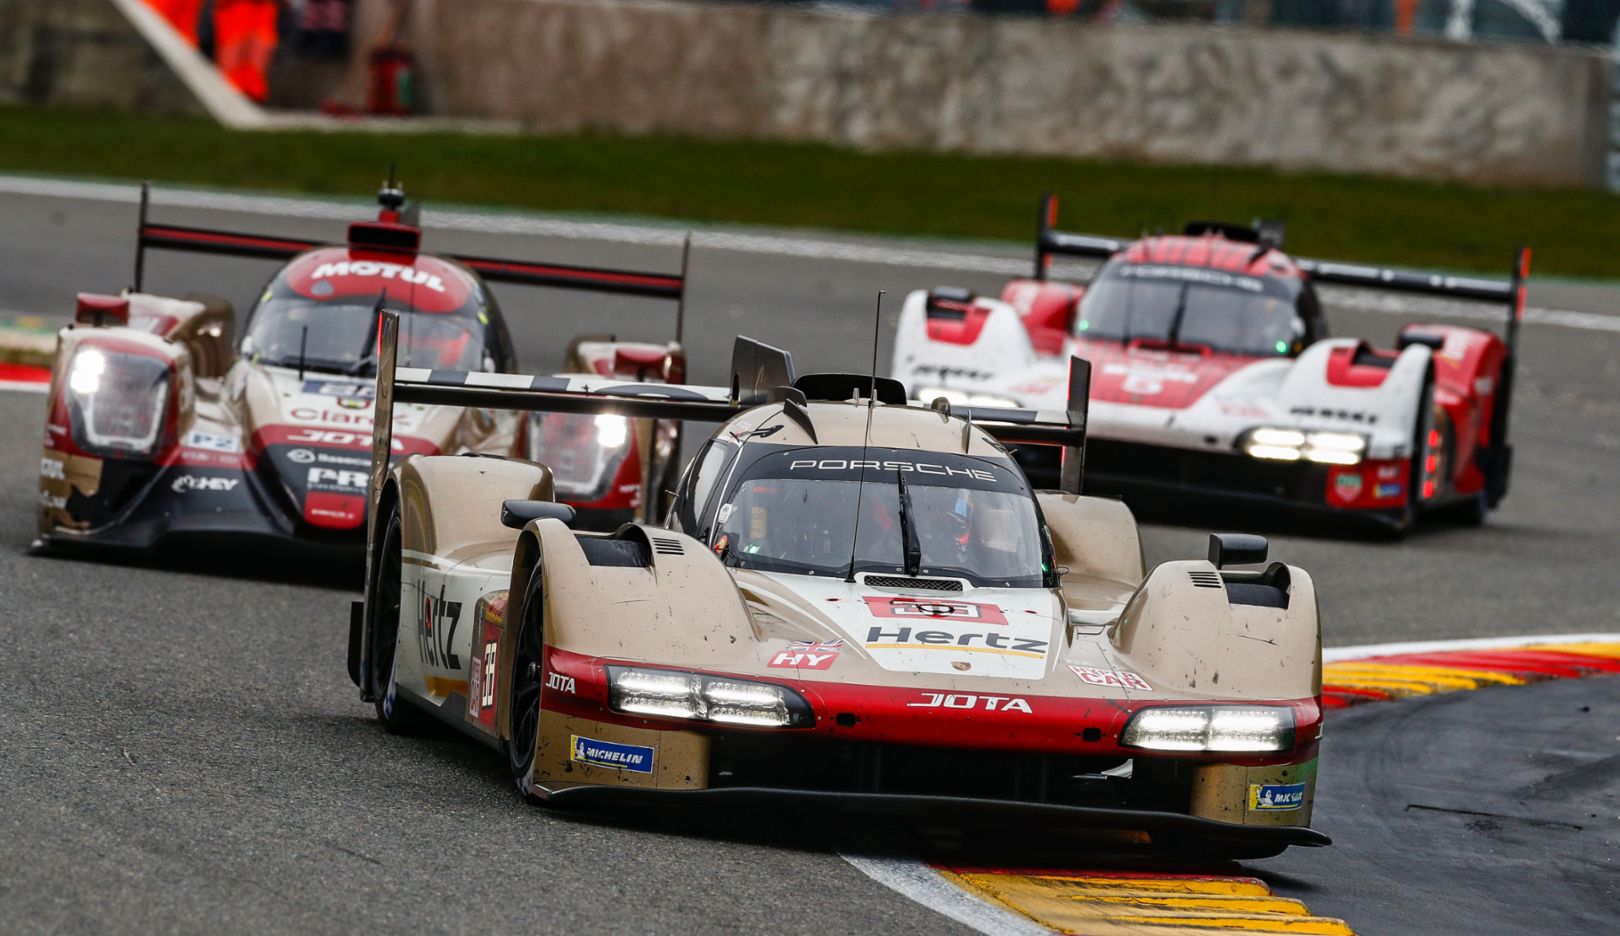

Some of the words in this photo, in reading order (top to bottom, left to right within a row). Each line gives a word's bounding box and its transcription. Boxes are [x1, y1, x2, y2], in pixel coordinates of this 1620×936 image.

[311, 260, 447, 293] MOTUL
[290, 407, 374, 426] Clar
[790, 459, 998, 483] PORSCHE
[417, 579, 462, 670] Hertz
[865, 626, 1049, 654] Hertz
[771, 652, 833, 669] HY
[545, 671, 576, 694] JOTA
[1080, 672, 1148, 690] CAR
[906, 692, 1033, 714] JOTA
[586, 747, 644, 765] MICHELIN
